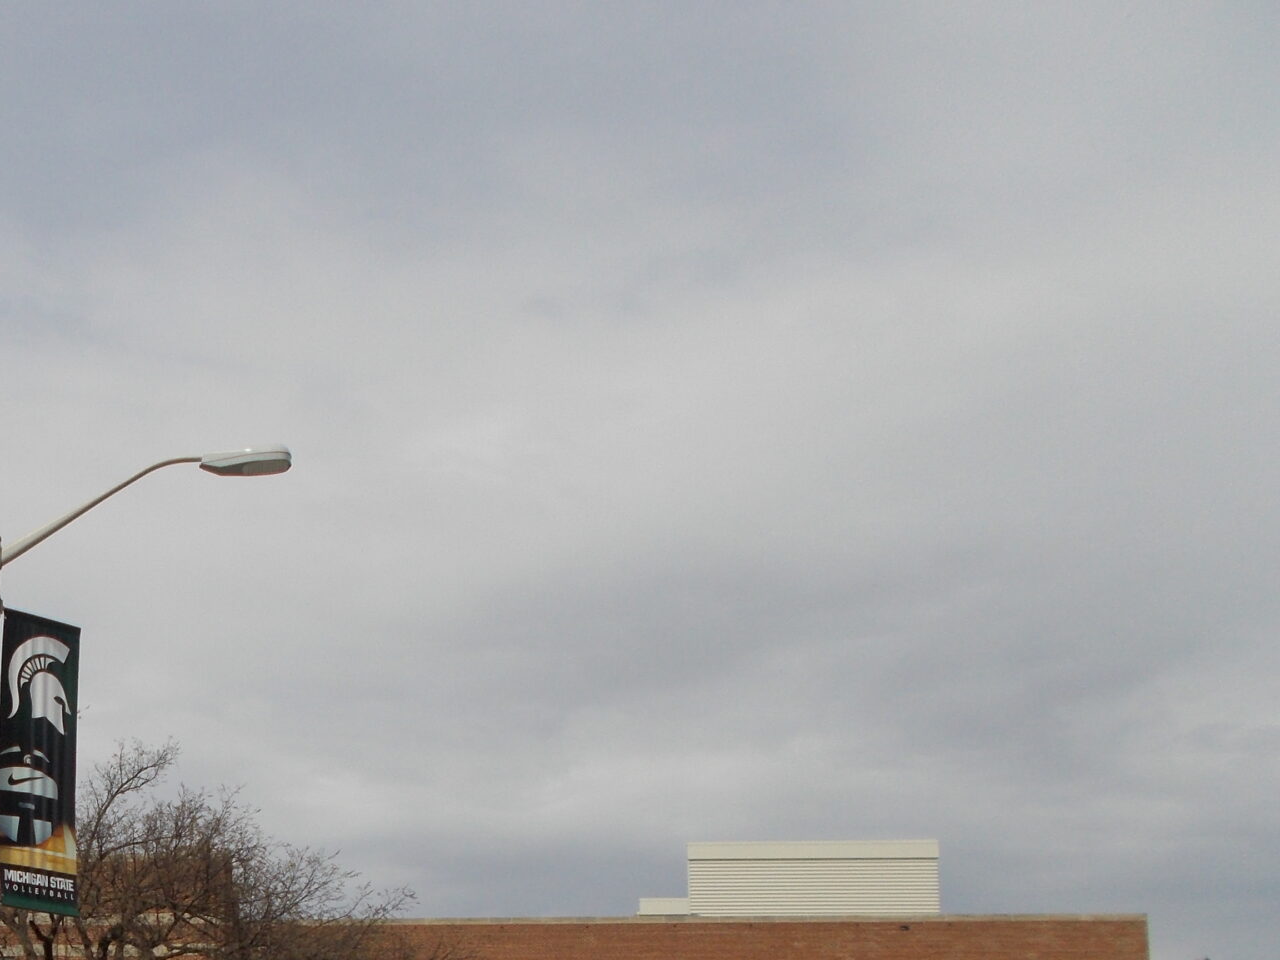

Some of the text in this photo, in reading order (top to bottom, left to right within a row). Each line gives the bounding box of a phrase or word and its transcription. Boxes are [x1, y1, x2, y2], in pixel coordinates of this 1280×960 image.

[4, 869, 74, 892] MICHIGAN STATE
[5, 883, 74, 900] VOLLEYBALL
